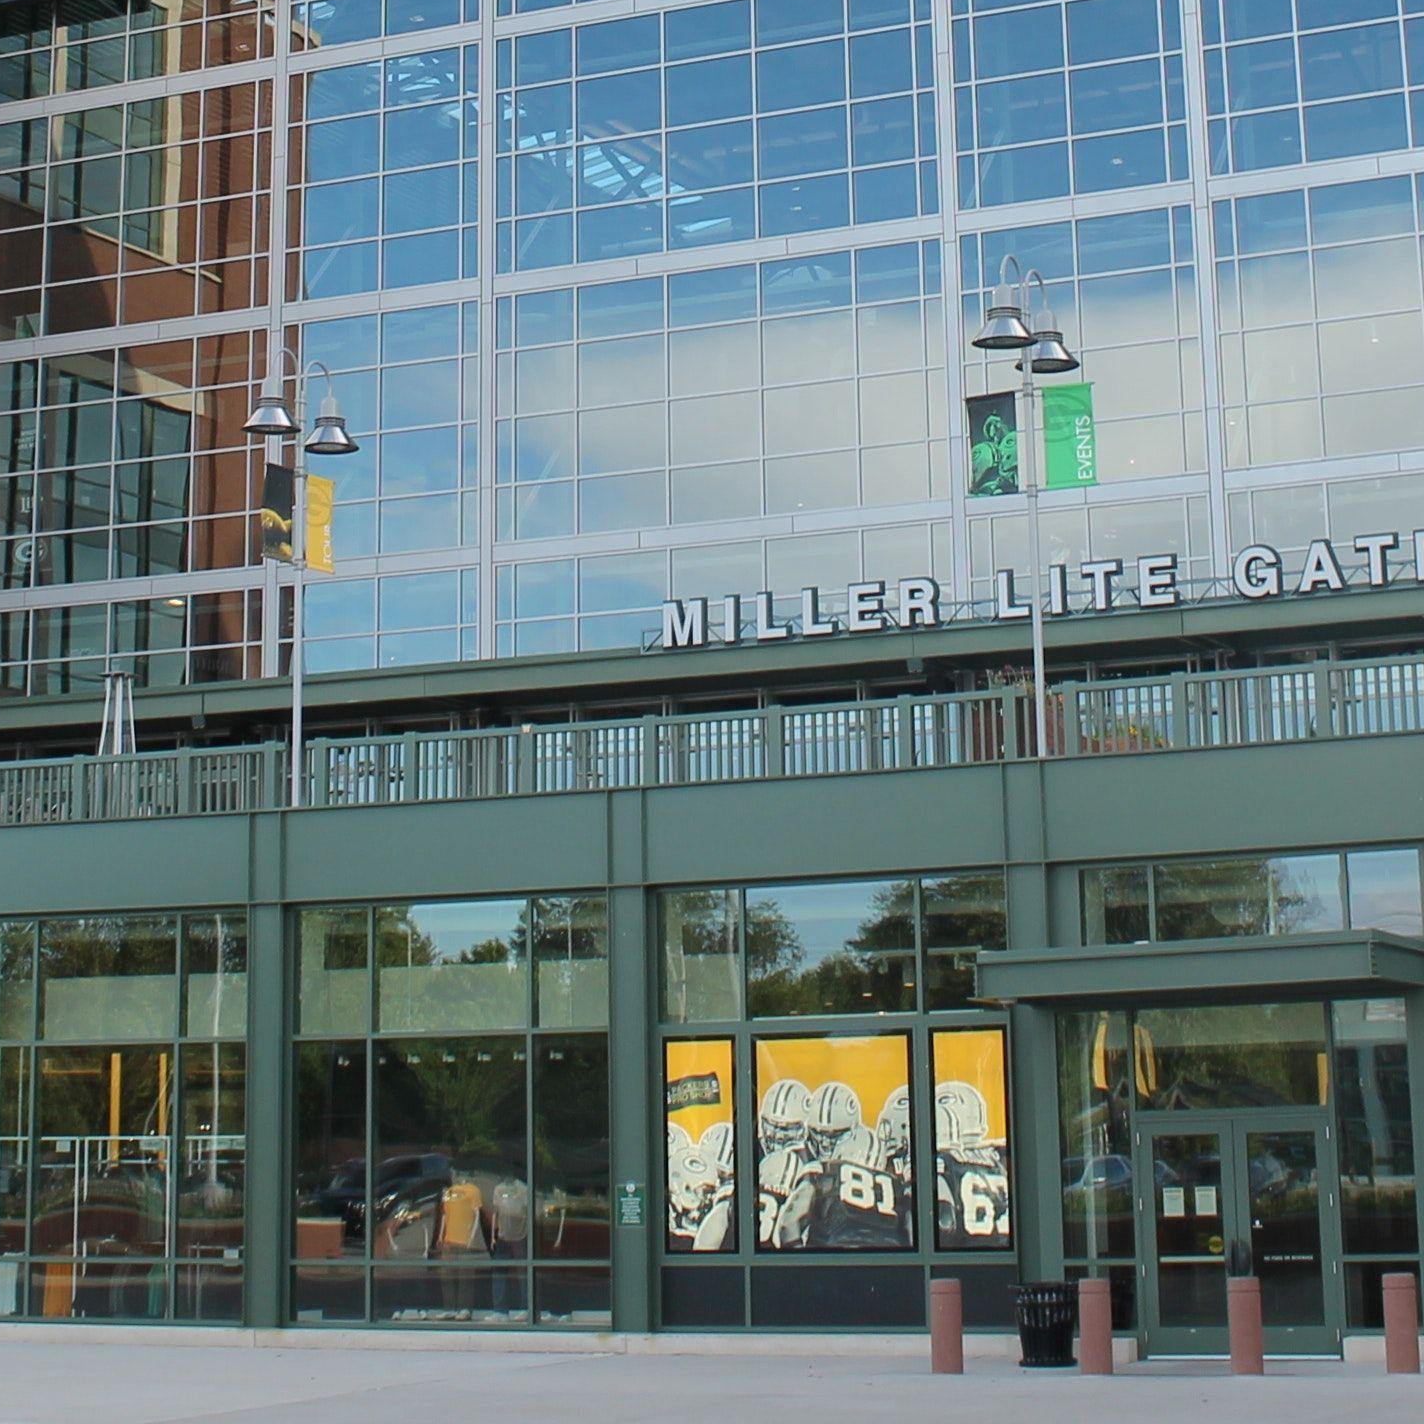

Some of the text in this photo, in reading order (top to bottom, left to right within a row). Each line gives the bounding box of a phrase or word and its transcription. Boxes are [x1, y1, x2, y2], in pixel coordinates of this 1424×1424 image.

[1076, 415, 1093, 480] EVENTS
[662, 577, 940, 649] MILLER
[996, 553, 1177, 619] LITE
[840, 1163, 898, 1216] 81
